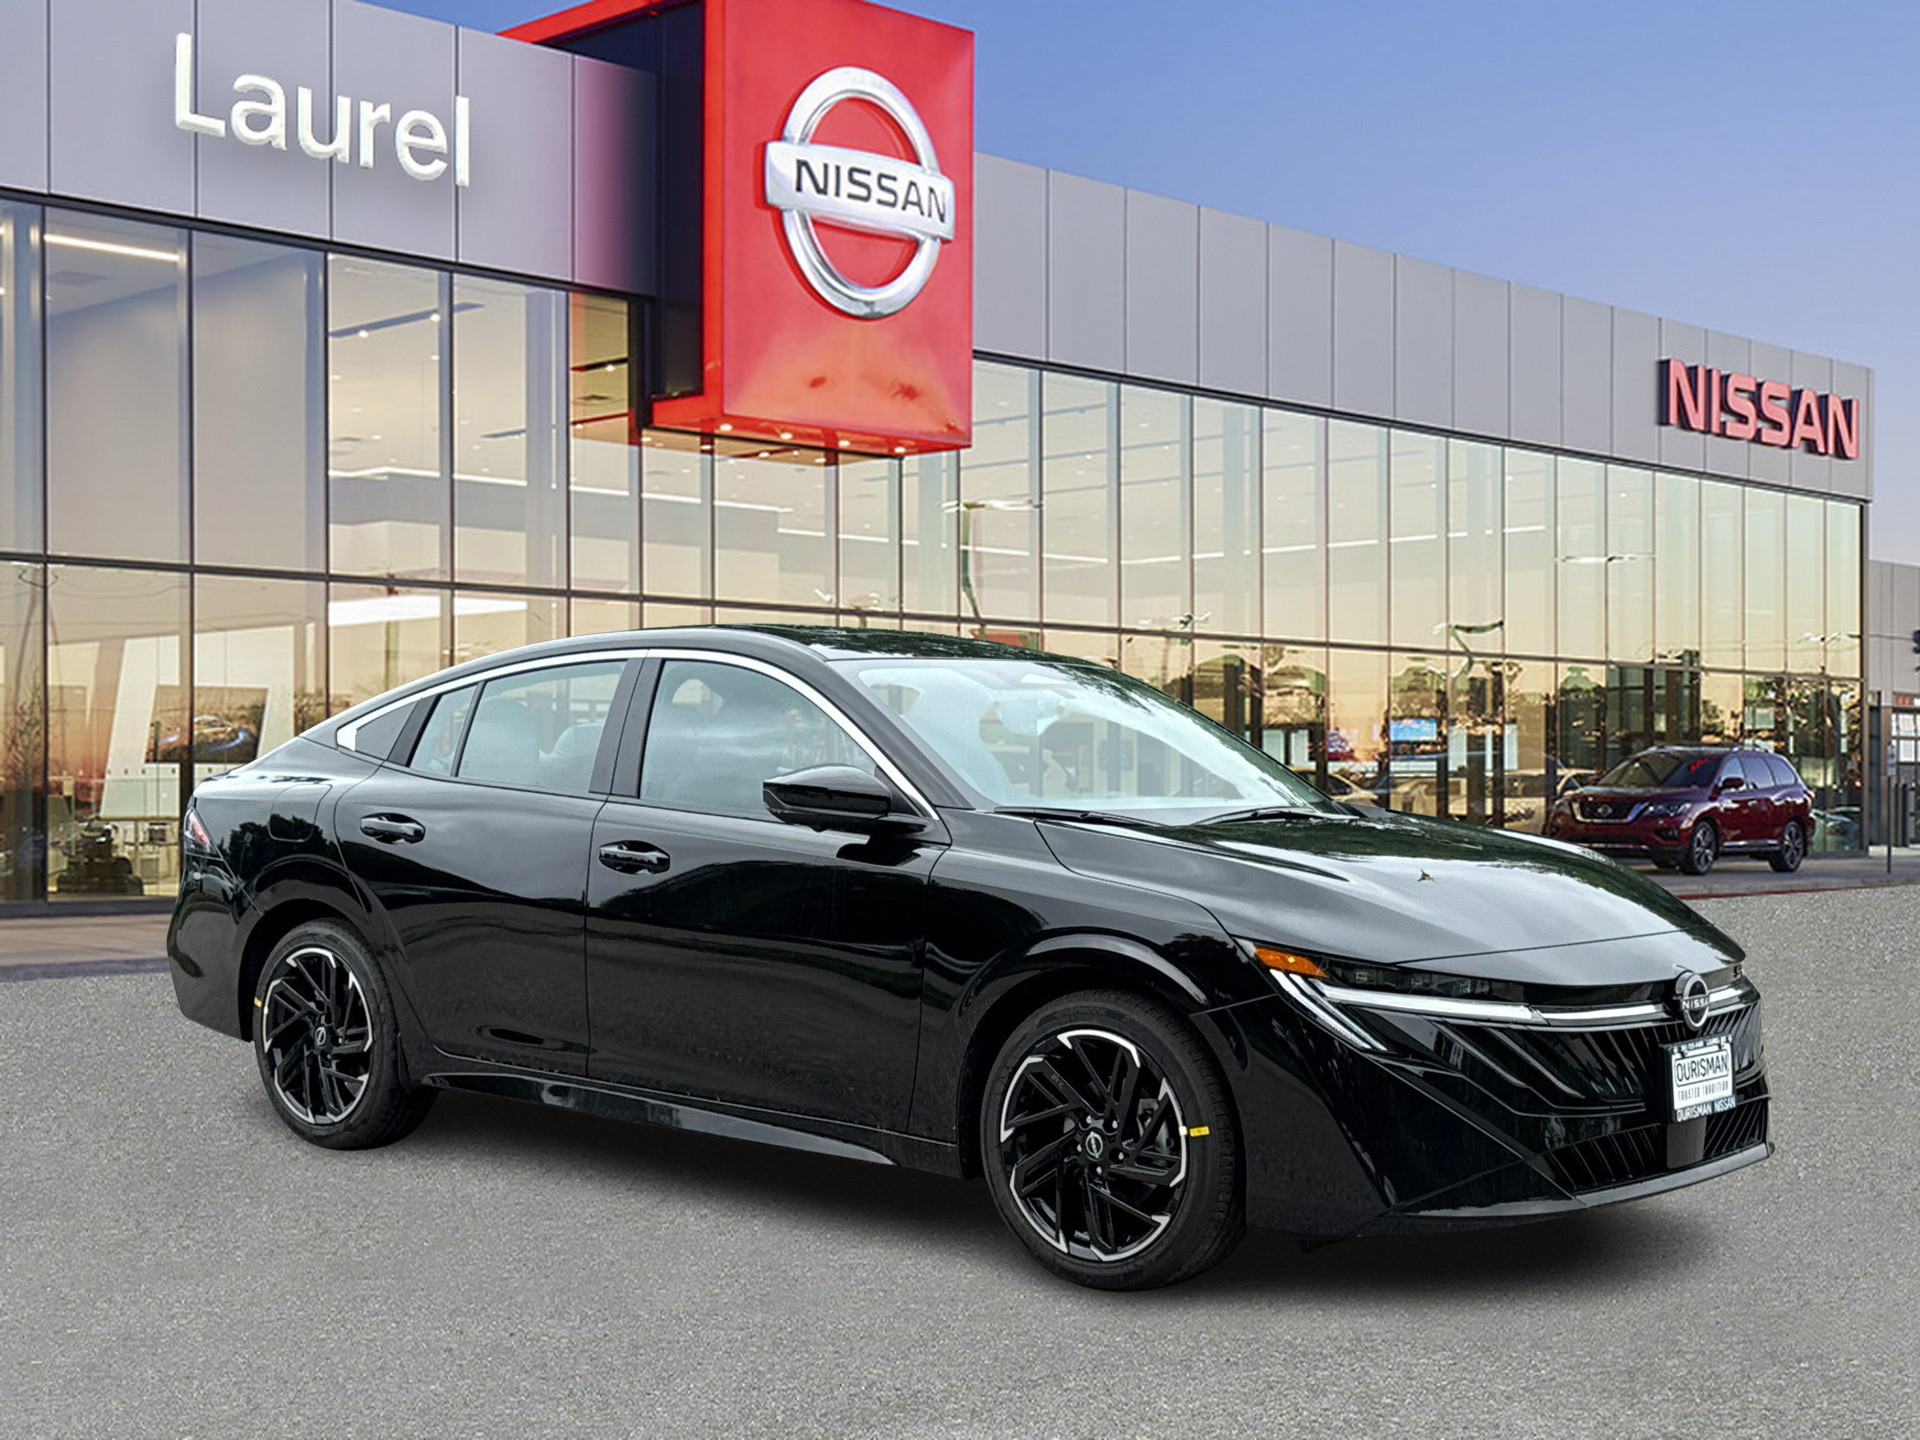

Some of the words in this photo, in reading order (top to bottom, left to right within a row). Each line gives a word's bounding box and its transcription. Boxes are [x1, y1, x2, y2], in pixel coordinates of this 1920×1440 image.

[175, 33, 471, 188] Laurel
[794, 158, 948, 224] NISSAN
[1666, 358, 1860, 459] NISSAN
[1676, 1055, 1728, 1082] OURISMAN
[1676, 1102, 1712, 1122] OURISMAN
[1714, 1095, 1736, 1113] NISSAN
